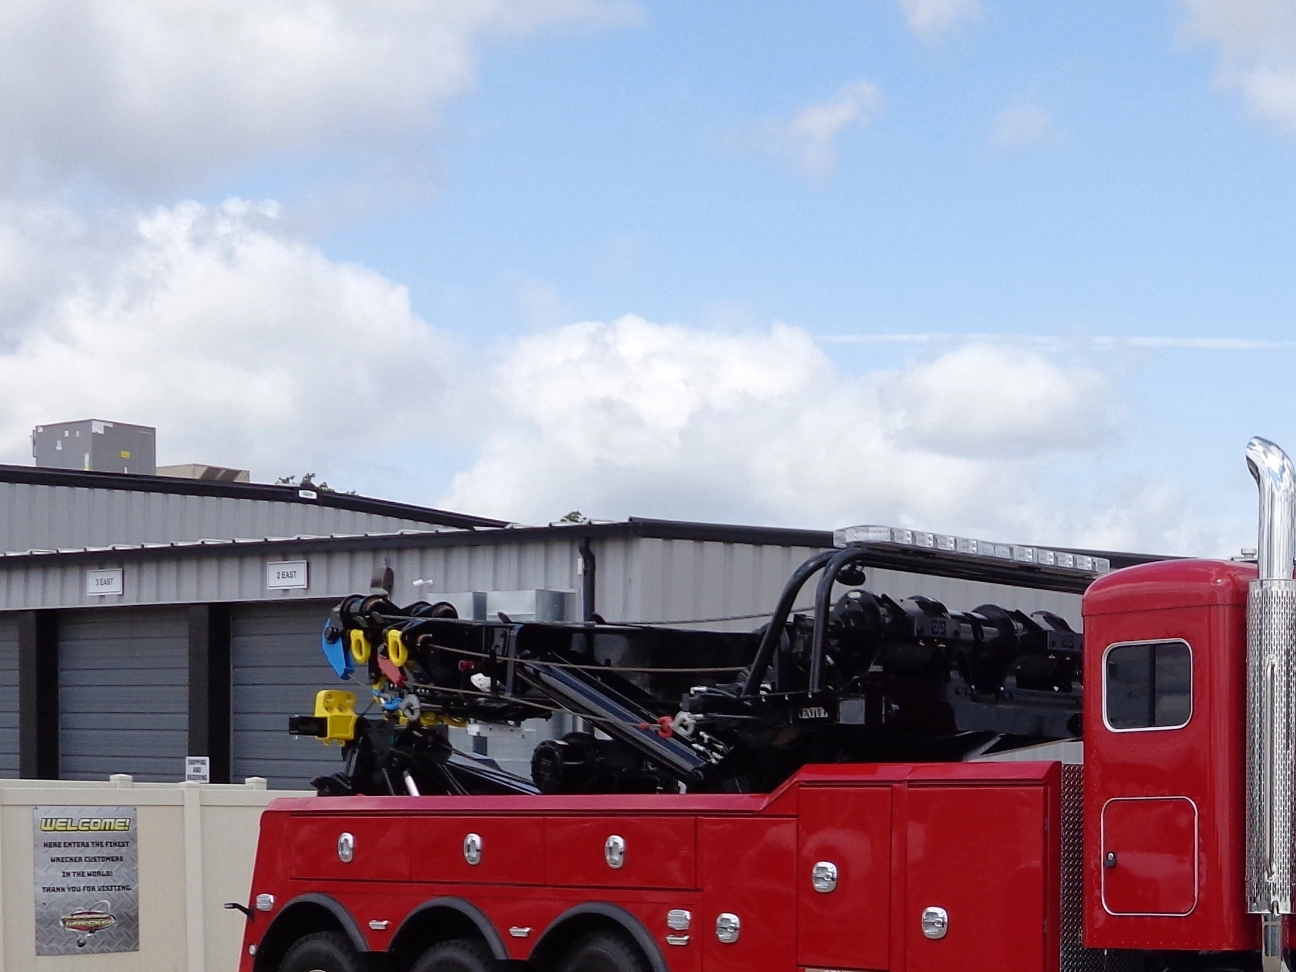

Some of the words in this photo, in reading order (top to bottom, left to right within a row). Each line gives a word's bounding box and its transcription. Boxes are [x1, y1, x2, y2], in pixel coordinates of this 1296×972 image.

[276, 571, 282, 579] 2
[281, 571, 297, 579] EAST
[99, 578, 114, 586] EAST
[40, 817, 132, 832] WELCOME!
[84, 855, 124, 863] CUSTOMERS
